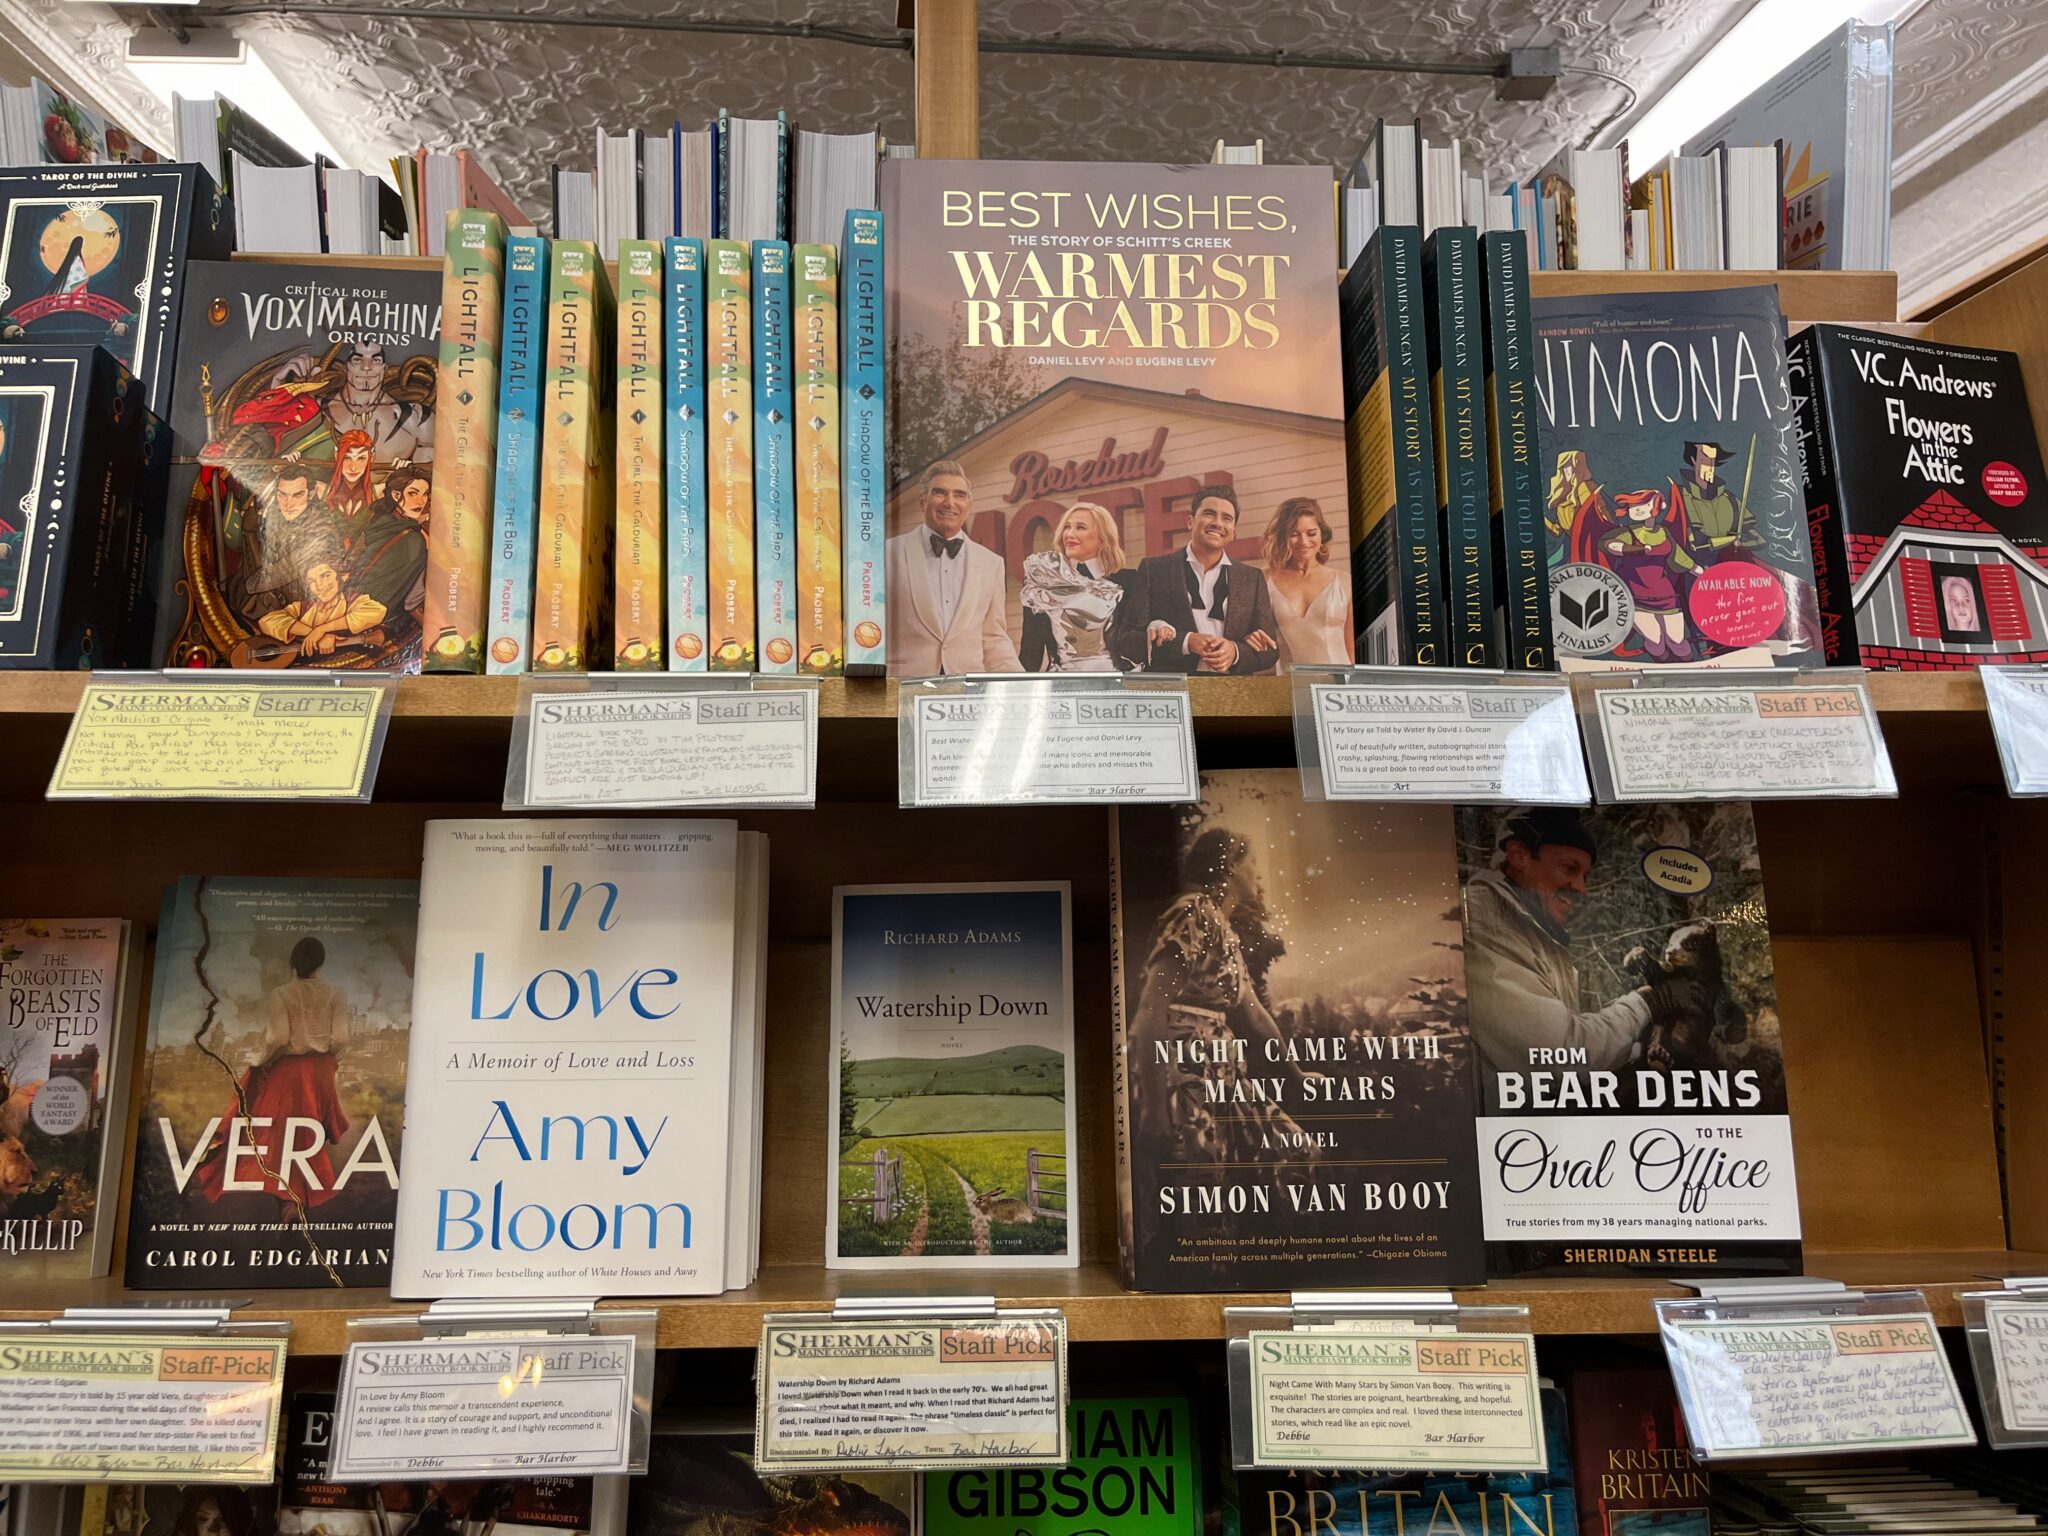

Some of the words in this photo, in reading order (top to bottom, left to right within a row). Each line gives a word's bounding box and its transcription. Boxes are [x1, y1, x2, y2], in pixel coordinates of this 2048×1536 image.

[943, 191, 1071, 228] BEST
[1085, 193, 1297, 234] WISHES,
[1009, 235, 1038, 246] THE
[1041, 235, 1090, 247] STORY
[1093, 236, 1113, 247] OF
[1116, 236, 1181, 248] SCHITT'S
[1184, 237, 1232, 248] CREEK
[948, 251, 1290, 300] WARMEST
[1500, 243, 1514, 278] DAVID
[285, 285, 348, 298] CRITICAL
[352, 288, 387, 299] ROLE
[1502, 281, 1515, 316] JAMES
[240, 293, 300, 341] VOX
[460, 267, 479, 378] LIGHTFALL
[856, 258, 875, 372] LIGHTFALL
[962, 301, 1280, 350] REGARDS
[328, 330, 410, 346] ORIGINS
[508, 285, 529, 396] LIGHTFALL
[631, 289, 647, 398] LIGHTFALL
[1505, 319, 1519, 370] DUNCAN
[1851, 335, 1875, 344] CLASSIC
[1878, 339, 1915, 351] BESTSELLING
[1916, 346, 1935, 355] NOVEL
[1946, 352, 1981, 360] FORBIDDEN
[1029, 356, 1073, 366] DANIEL
[1075, 356, 1105, 366] LEVY
[1108, 357, 1133, 366] AND
[1136, 357, 1184, 367] EUGENE
[1186, 357, 1216, 367] LEVY
[1851, 349, 1894, 387] V.C.
[1509, 381, 1524, 406] MY
[1534, 331, 1772, 429] NIMONA
[1885, 397, 1973, 445] Flowers
[860, 410, 874, 469] SHADOW
[1513, 411, 1527, 466] STORY
[1921, 439, 1933, 455] in
[1934, 438, 1958, 459] the
[1003, 427, 1169, 503] Rosebud
[1903, 444, 1965, 484] Attic
[860, 472, 872, 490] OF
[1515, 471, 1530, 490] AS
[860, 493, 871, 512] THE
[1517, 494, 1533, 543] TOLD
[859, 515, 872, 542] BIRD
[1520, 550, 1535, 571] BY
[448, 567, 461, 613] PROBERT
[862, 561, 873, 608] PROBERT
[1576, 567, 1610, 586] BOOK
[1609, 583, 1628, 628] AWARD
[1698, 578, 1746, 591] AVAILABLE
[1750, 577, 1772, 588] NOW
[501, 579, 514, 625] PROBERT
[1522, 576, 1540, 637] WATER
[1556, 631, 1612, 650] FINALIST
[1346, 726, 1365, 734] Story
[1393, 726, 1402, 734] by
[1427, 726, 1436, 734] By
[1659, 855, 1699, 874] Includes
[1660, 870, 1693, 887] Acadia
[538, 865, 621, 931] In
[884, 929, 959, 945] RICHARD
[964, 929, 1021, 944] ADAMS
[42, 953, 68, 966] THE
[0, 962, 103, 990] FORGOTTEN
[470, 952, 682, 1021] Love
[9, 989, 101, 1028] BEASTS
[855, 995, 972, 1024] Watership
[978, 994, 1048, 1017] Down
[35, 1017, 54, 1031] OF
[53, 1016, 98, 1048] ELD
[446, 1052, 460, 1070] A
[468, 1053, 537, 1069] Memoir
[544, 1051, 564, 1072] of
[568, 1052, 609, 1069] Love
[616, 1051, 649, 1068] and
[656, 1051, 695, 1068] Loss
[1154, 1038, 1248, 1064] NIGHT
[1264, 1037, 1347, 1062] CAME
[1363, 1035, 1440, 1060] WITH
[1528, 1047, 1587, 1065] FROM
[1205, 1078, 1287, 1103] MANY
[1303, 1076, 1396, 1101] STARS
[1497, 1071, 1620, 1109] BEAR
[1636, 1069, 1761, 1109] DENS
[469, 1100, 668, 1176] Amy
[1260, 1133, 1271, 1148] A
[1280, 1132, 1338, 1148] NOVEL
[1695, 1127, 1714, 1139] TO
[1716, 1127, 1743, 1139] THE
[159, 1114, 400, 1194] VERA
[1494, 1128, 1617, 1194] Oval
[1630, 1127, 1770, 1214] Office
[1159, 1185, 1271, 1215] SIMON
[1288, 1183, 1347, 1212] VAN
[1364, 1181, 1451, 1210] BOOY
[435, 1179, 692, 1252] Bloom
[1506, 1217, 1527, 1227] True
[1528, 1217, 1560, 1227] stories
[1563, 1217, 1585, 1227] from
[1587, 1219, 1600, 1229] my
[1602, 1217, 1615, 1226] 38
[1617, 1218, 1643, 1229] years
[1645, 1217, 1693, 1229] managing
[1695, 1216, 1735, 1226] national
[1738, 1216, 1767, 1228] parks.
[0, 1219, 83, 1255] KILLIP
[146, 1250, 236, 1267] CAROL
[250, 1248, 391, 1267] EDGARIAN
[1564, 1248, 1651, 1263] SHERIDAN
[1657, 1248, 1717, 1263] STEELE
[775, 1331, 933, 1357] SHERMAN'S
[943, 1333, 995, 1356] Staff
[1005, 1333, 1053, 1355] Pick
[778, 1380, 815, 1389] Watership
[816, 1379, 836, 1387] Down
[839, 1379, 847, 1387] by
[1269, 1380, 1290, 1390] Night
[1291, 1381, 1313, 1389] Came
[1315, 1381, 1333, 1389] With
[1335, 1381, 1356, 1390] Many
[1358, 1381, 1377, 1389] Stars
[1379, 1381, 1388, 1391] by
[1390, 1381, 1414, 1389] Simon
[1415, 1382, 1431, 1390] Van
[1433, 1382, 1455, 1391] Booy.
[1276, 1431, 1311, 1442] Debbie
[1424, 1433, 1444, 1443] Bar
[1447, 1433, 1485, 1444] Harbor
[1608, 1448, 1704, 1471] KRISTEN
[948, 1465, 1176, 1518] GIBSON
[1601, 1473, 1711, 1499] BRITAIN
[1267, 1489, 1554, 1536] BRITAIN
